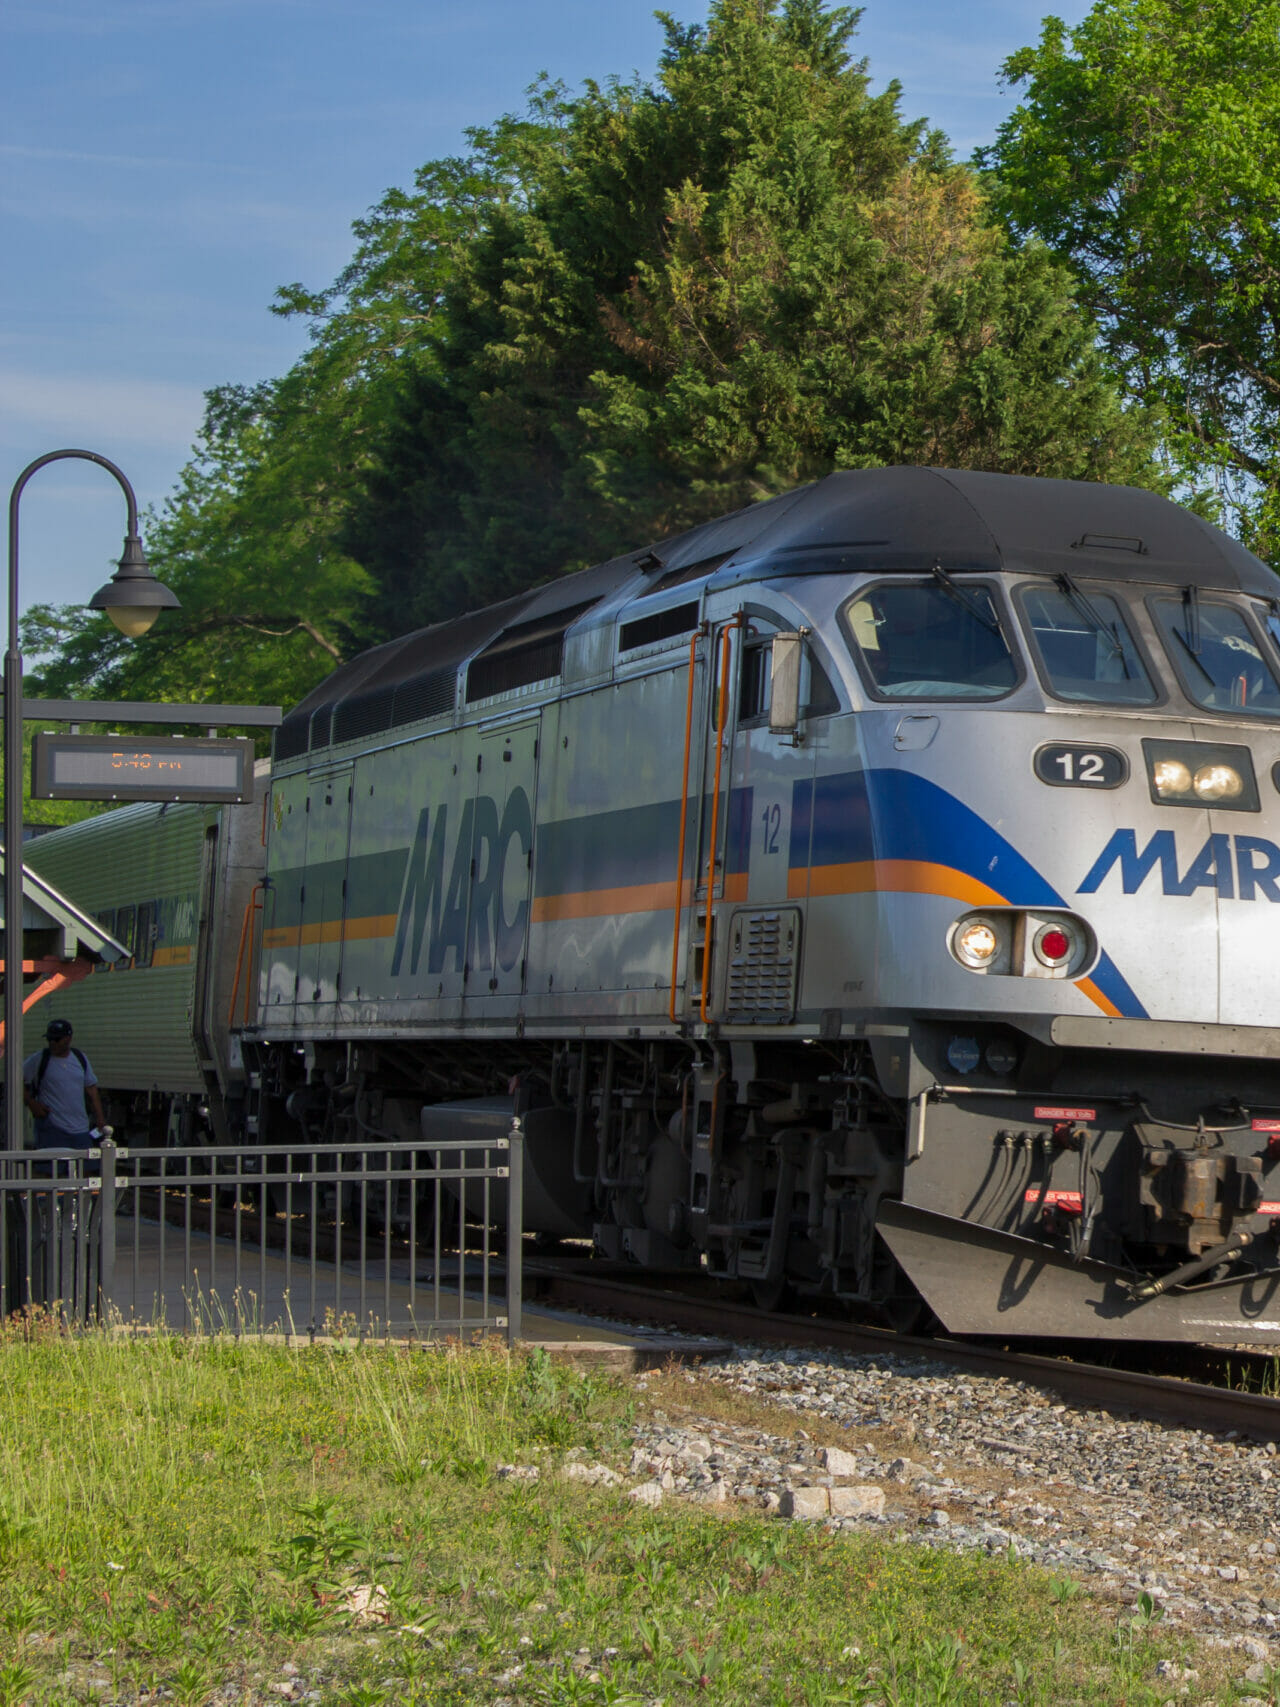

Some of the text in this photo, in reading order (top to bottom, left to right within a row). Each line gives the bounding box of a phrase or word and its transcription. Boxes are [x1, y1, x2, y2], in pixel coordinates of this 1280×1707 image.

[1056, 753, 1105, 782] 12
[762, 803, 781, 855] 12
[390, 785, 533, 977] MARC
[1038, 1108, 1064, 1117] DANGER
